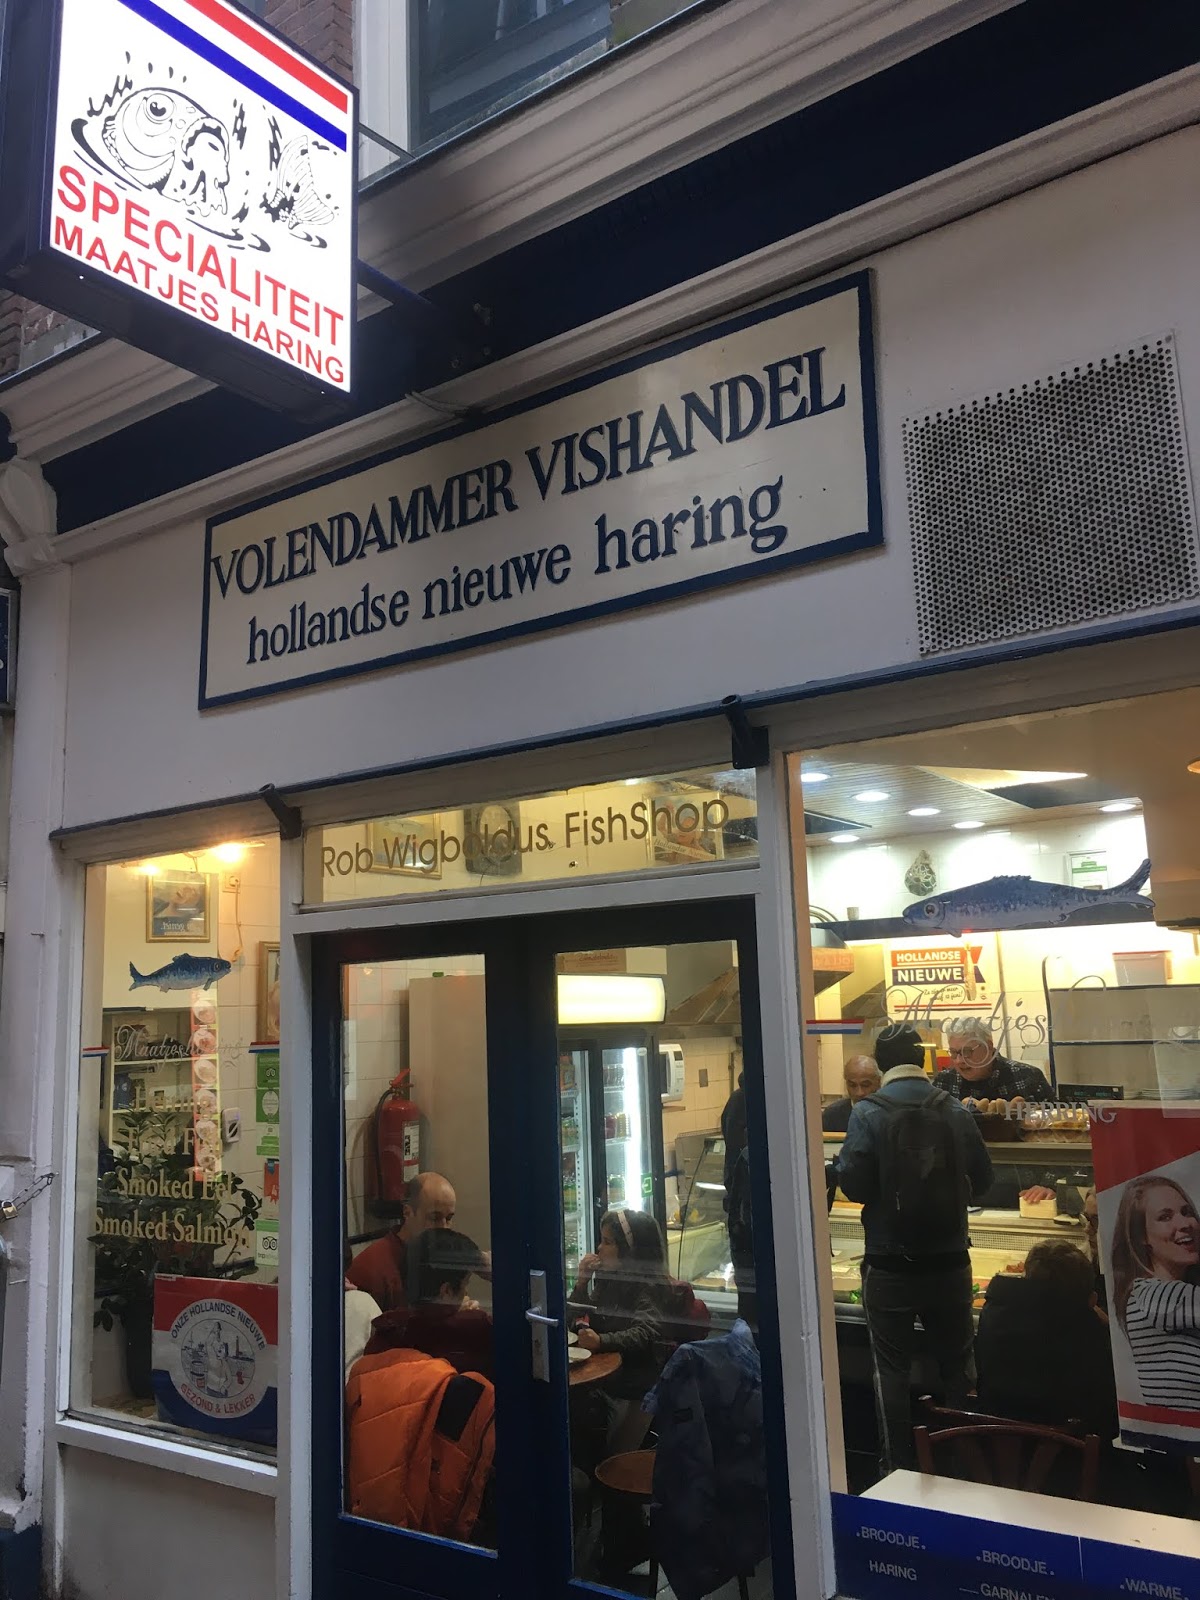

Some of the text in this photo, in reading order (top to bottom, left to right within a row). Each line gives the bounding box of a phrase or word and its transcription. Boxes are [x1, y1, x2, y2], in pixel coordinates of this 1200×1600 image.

[57, 165, 344, 346] SPECIALITEIT
[55, 216, 344, 384] MAATJES HARING
[211, 347, 846, 600] VOLENDAMMER VISHANDEL
[246, 475, 788, 665] hollandse nieuwe haring
[322, 842, 373, 878] Rob
[383, 821, 548, 873] Wigboldus
[896, 950, 961, 962] HOLLANDSE
[897, 967, 963, 983] NIEUWE
[1004, 1100, 1117, 1123] HERRING
[116, 1167, 195, 1200] Smoked
[201, 1171, 232, 1202] Eel
[95, 1207, 250, 1249] Smoked Salmon
[171, 1301, 266, 1351] ONZE HOLLANDSE NIEUWE
[180, 1382, 256, 1414] GEZOND & LEKKER
[869, 1560, 917, 1581] HARING
